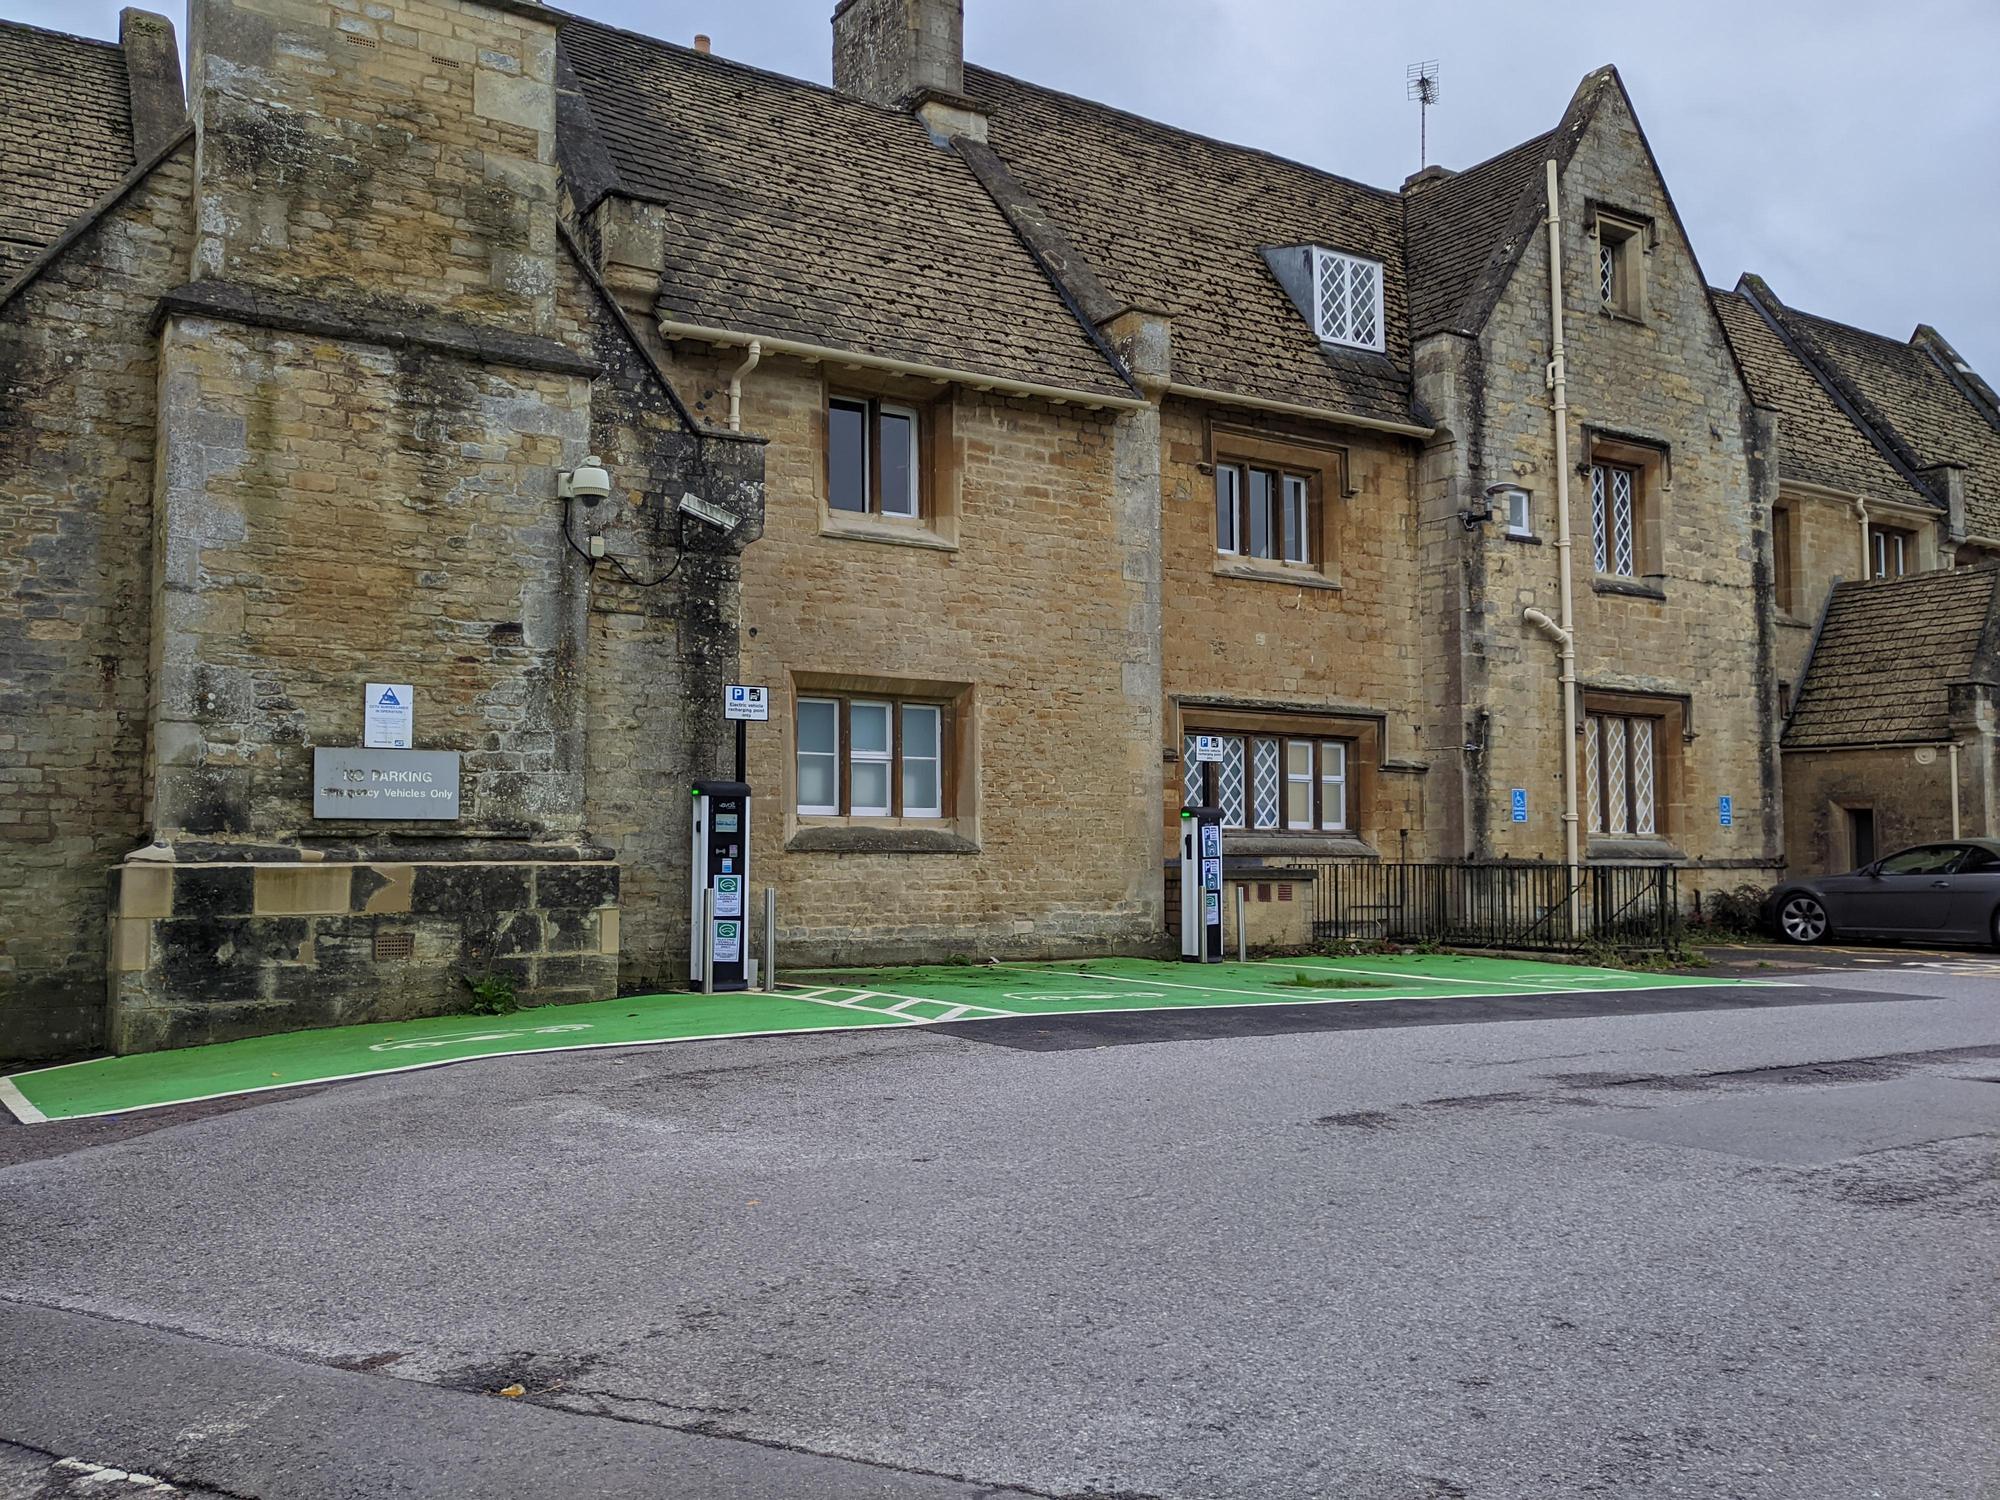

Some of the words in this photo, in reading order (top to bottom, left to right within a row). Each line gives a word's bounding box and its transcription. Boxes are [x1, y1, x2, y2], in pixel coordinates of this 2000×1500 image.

[343, 769, 365, 782] NO
[371, 769, 433, 783] PARKING
[384, 788, 426, 798] Vehicles
[430, 789, 453, 800] Only
